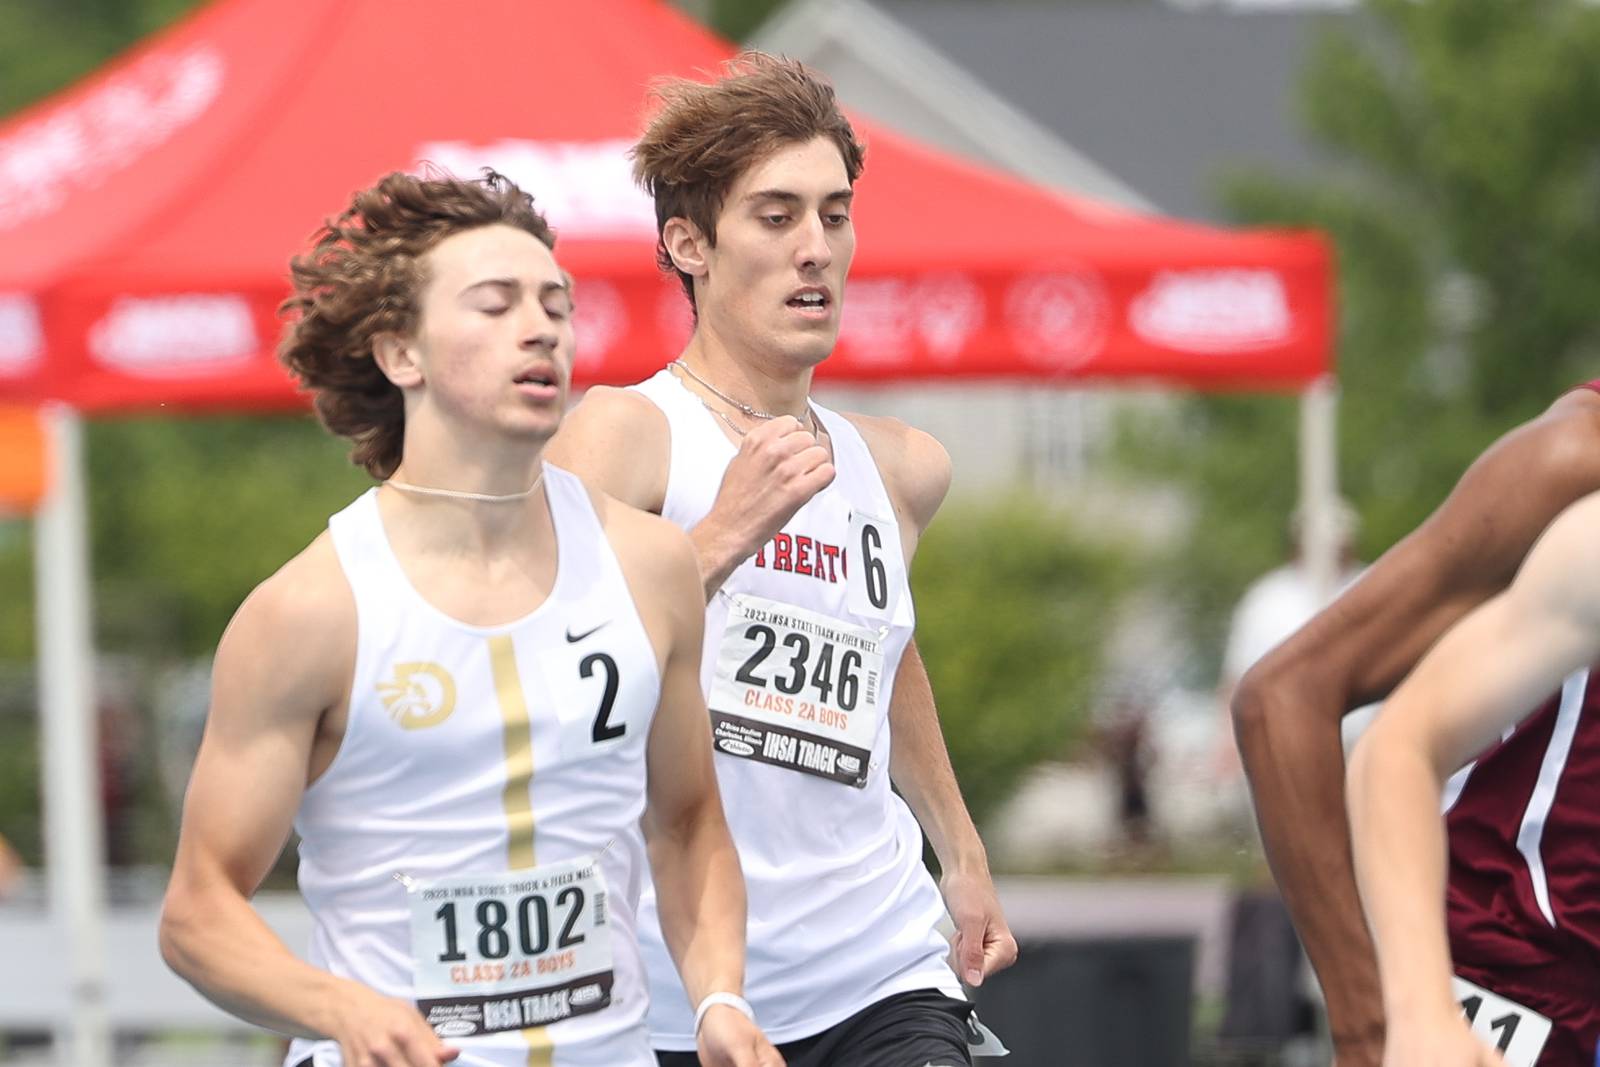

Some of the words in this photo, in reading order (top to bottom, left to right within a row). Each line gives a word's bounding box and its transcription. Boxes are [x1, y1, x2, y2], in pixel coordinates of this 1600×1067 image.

[861, 524, 888, 610] 6
[743, 608, 767, 622] 2023
[791, 619, 813, 633] STATE
[814, 625, 835, 640] TRACK
[841, 634, 859, 648] FIELD
[859, 639, 877, 653] MEET
[735, 624, 862, 712] 2346
[579, 652, 626, 743] 2
[744, 687, 795, 716] CLASS
[797, 701, 817, 721] 2A
[819, 706, 849, 731] BOYS
[762, 731, 797, 764] IHSA
[797, 739, 838, 774] TRACK
[435, 886, 586, 962] 1802
[450, 963, 505, 985] CLASS
[510, 958, 531, 979] 2A
[536, 951, 576, 975] BOYS
[521, 987, 571, 1025] TRACK
